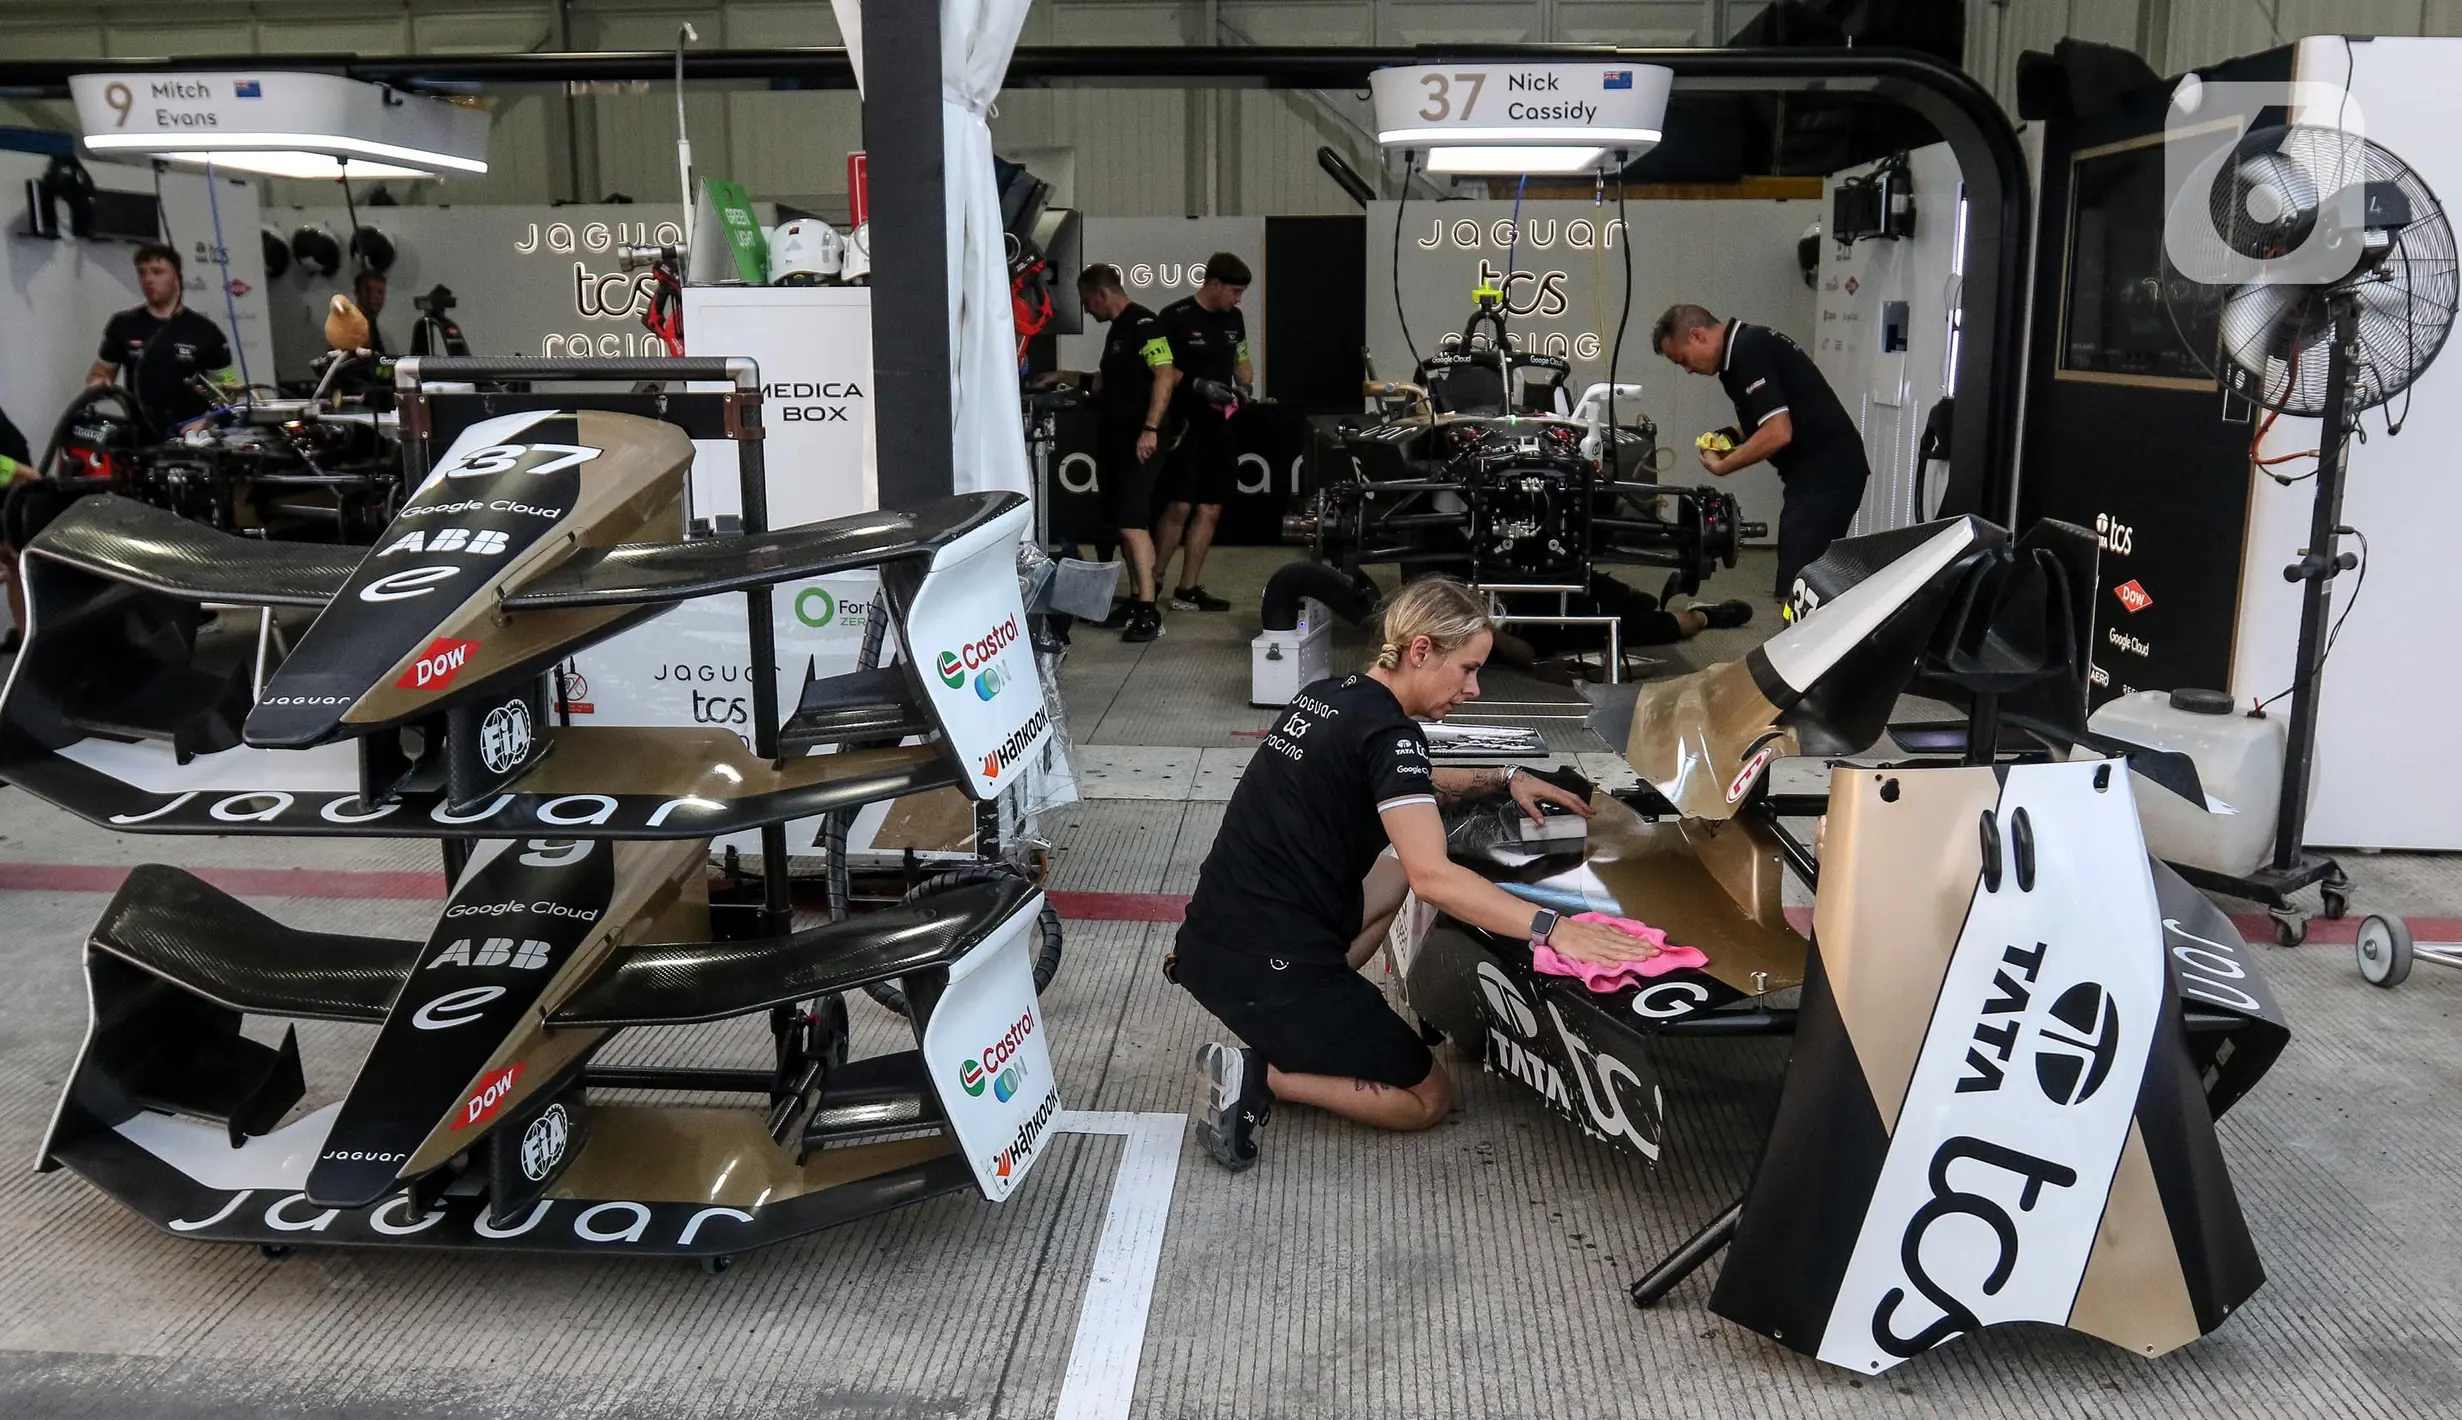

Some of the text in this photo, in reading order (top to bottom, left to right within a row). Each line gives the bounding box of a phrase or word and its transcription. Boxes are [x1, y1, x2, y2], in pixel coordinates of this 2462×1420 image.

[151, 80, 210, 98] Mitch
[1508, 72, 1559, 91] Nick
[104, 82, 133, 127] 9
[1418, 73, 1486, 122] 37
[1508, 101, 1598, 124] Cassidy
[155, 108, 218, 126] Evans
[783, 406, 848, 421] BOX
[446, 443, 604, 479] 37
[400, 500, 562, 519] Google Cloud
[376, 528, 510, 557] ABB
[2110, 515, 2133, 556] tcs
[840, 617, 866, 626] ZER
[962, 612, 1019, 670] Castrol
[2109, 627, 2150, 657] Google Cloud
[692, 689, 748, 723] tcs
[1415, 740, 1428, 760] tc
[1397, 765, 1421, 775] Google
[445, 899, 599, 921] Google Cloud
[425, 938, 552, 970] ABB
[1955, 941, 2048, 1093] TATA
[983, 1004, 1035, 1074] Castrol
[1490, 1027, 1571, 1111] TATA
[1872, 1135, 2077, 1358] tcs
